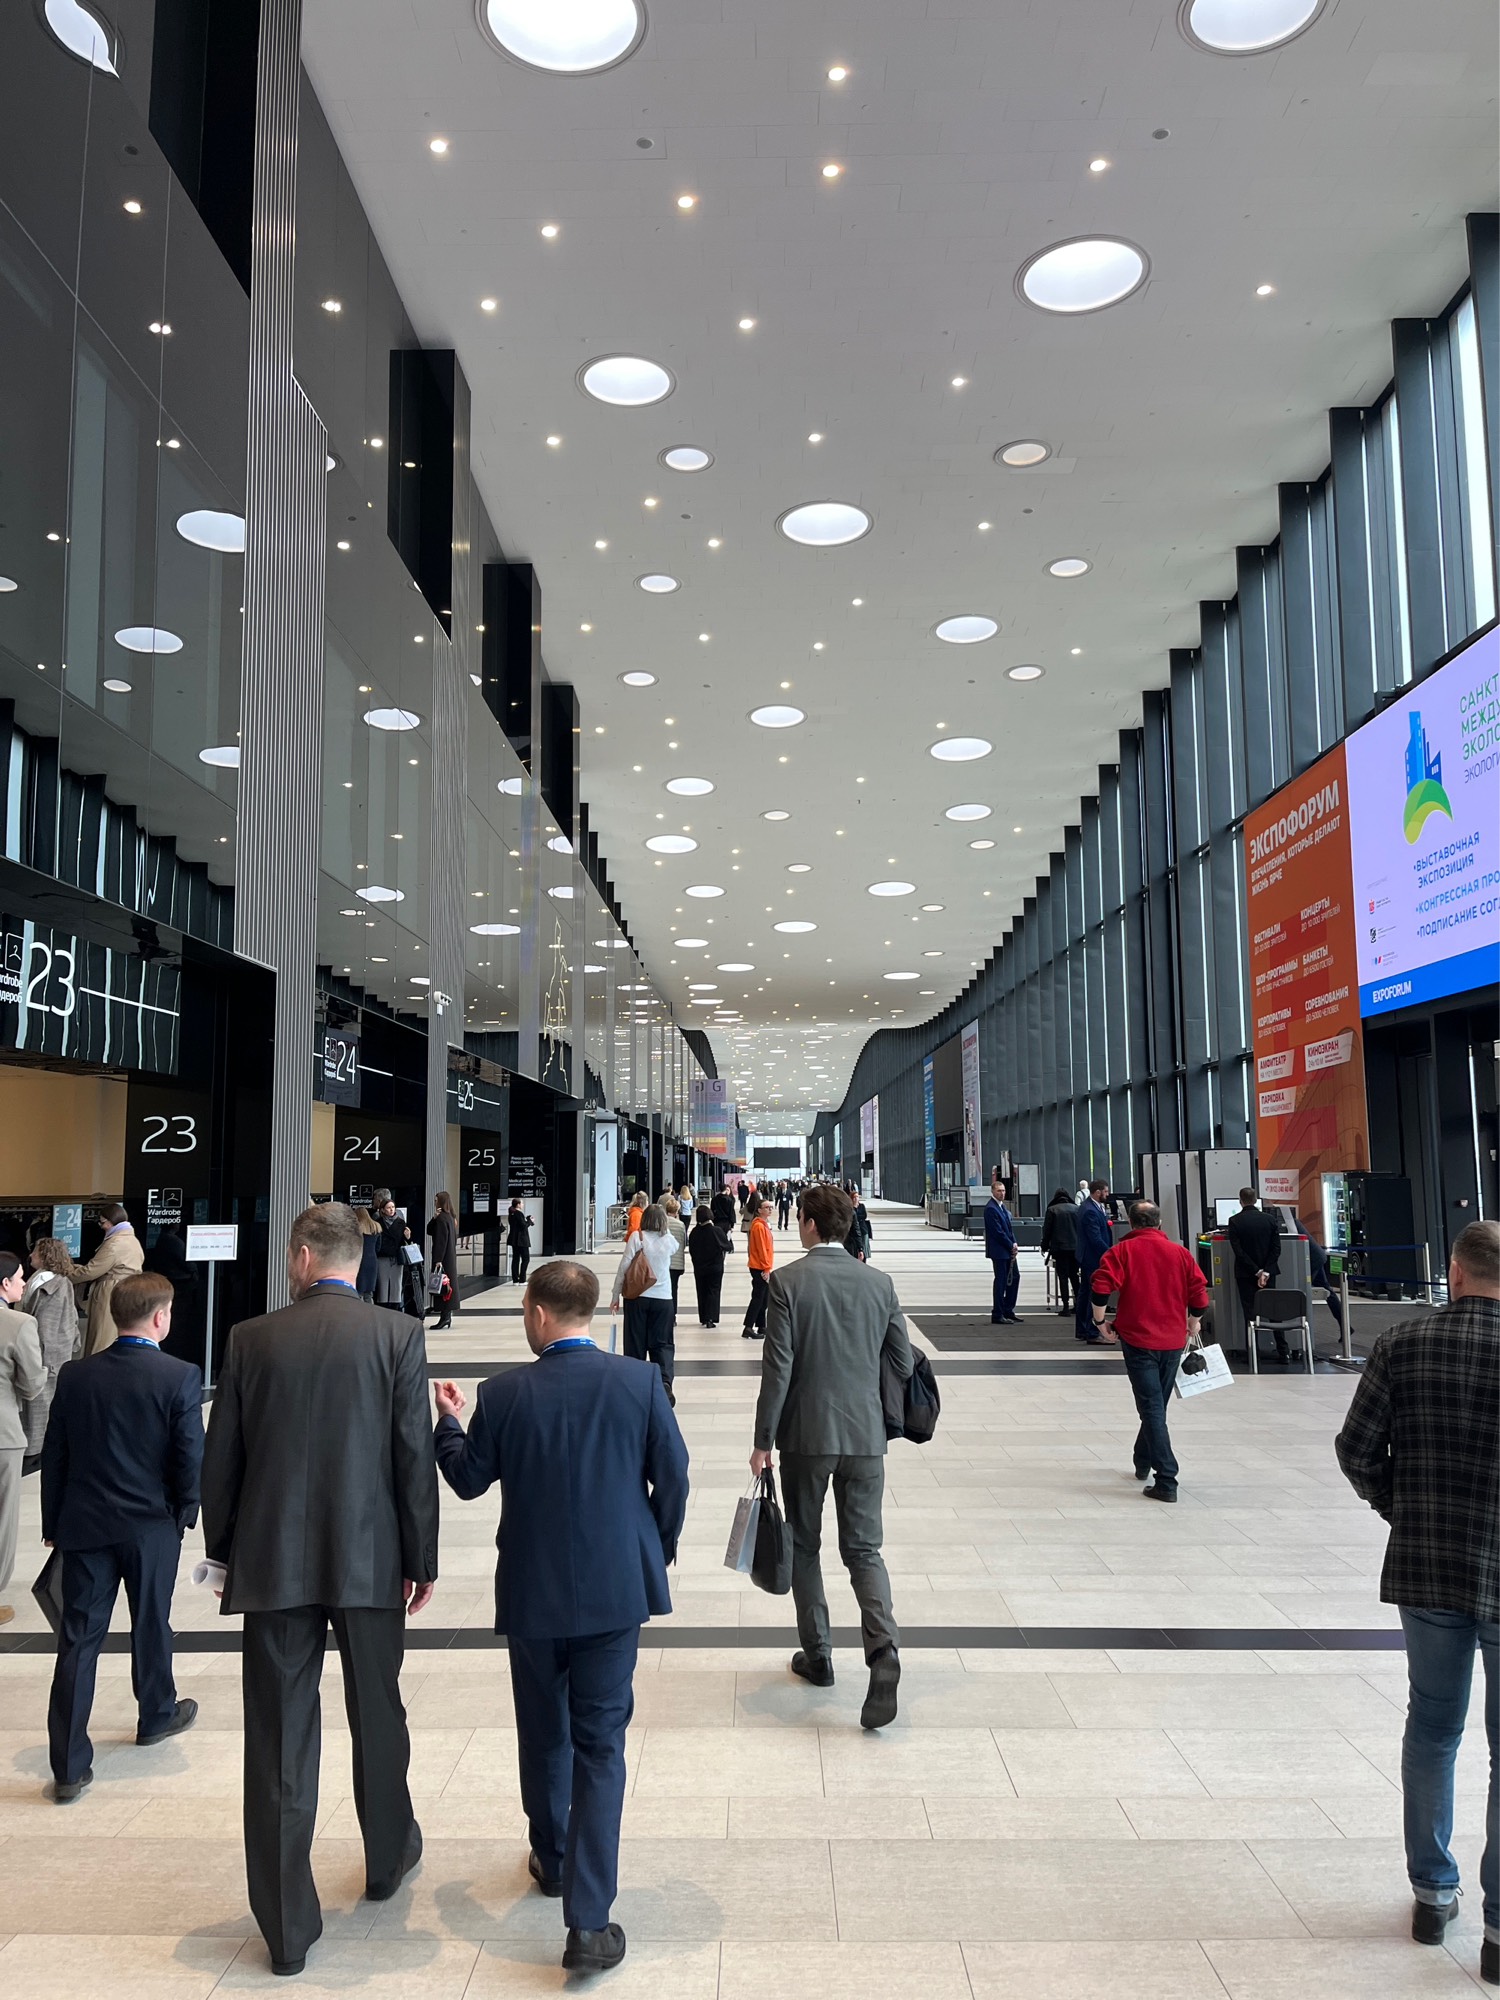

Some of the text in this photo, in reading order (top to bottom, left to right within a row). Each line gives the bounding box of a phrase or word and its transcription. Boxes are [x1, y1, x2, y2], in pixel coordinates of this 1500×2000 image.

[1250, 779, 1340, 865] ЭКСПОФОРУМ
[1287, 832, 1314, 860] КОТОРЫЕ
[1314, 815, 1341, 845] ДЕЛАЮТ
[1416, 831, 1480, 872] ВЫСТАВОЧНАЯ
[1252, 868, 1283, 897] ЖИЗНЬ ЯРЧЕ
[1418, 853, 1474, 888] ЭКСПОЗИЦИЯ
[1301, 896, 1330, 921] КОНЦЕРТЫ
[1418, 879, 1479, 914] КОНГРЕССНАЯ
[1420, 905, 1478, 938] ПОДПИСАНИЕ
[1480, 897, 1500, 916] СОГ
[1254, 922, 1281, 944] ФЕСТИВАЛИ
[1303, 945, 1329, 965] БАНКЕТЫ
[26, 942, 76, 1017] 23
[1256, 958, 1299, 986] ШОУ-ПРОГРАММЫ
[1305, 985, 1350, 1011] СОРЕВНОВАНИЯ
[1372, 980, 1412, 1004] EXPOFORUM
[1258, 1007, 1292, 1028] КОРПОРАТИВЫ
[1307, 1040, 1340, 1058] КИНОЭКРАН
[337, 1041, 356, 1085] 24
[1260, 1055, 1287, 1070] АМФИТЕАТР
[464, 1081, 474, 1111] 25
[712, 1081, 722, 1092] G
[1261, 1092, 1285, 1105] ПАРКОВКА
[141, 1116, 197, 1153] 23
[600, 1131, 609, 1151] 1
[343, 1136, 381, 1161] 24
[468, 1149, 495, 1166] 25
[147, 1189, 159, 1205] F
[349, 1185, 358, 1197] F
[473, 1183, 479, 1192] F
[66, 1209, 81, 1228] 24
[147, 1216, 181, 1225] Гардероб
